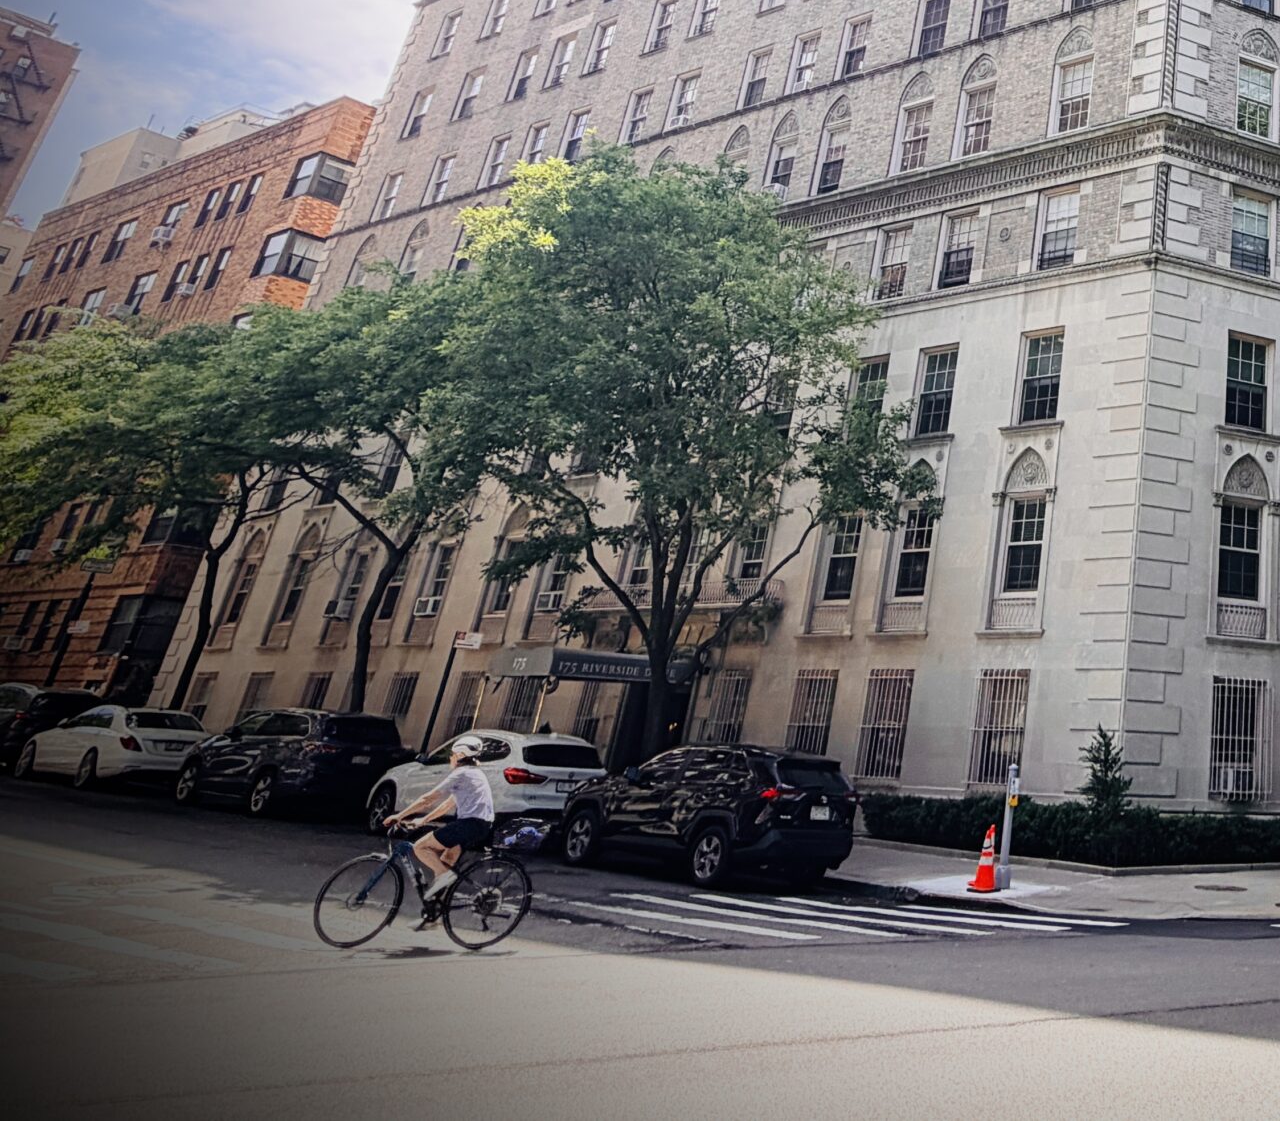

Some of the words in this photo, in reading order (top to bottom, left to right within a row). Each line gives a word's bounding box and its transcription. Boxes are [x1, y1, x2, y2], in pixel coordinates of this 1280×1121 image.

[512, 658, 527, 671] 175
[558, 661, 578, 674] 175
[581, 662, 640, 676] RIVERSIDE
